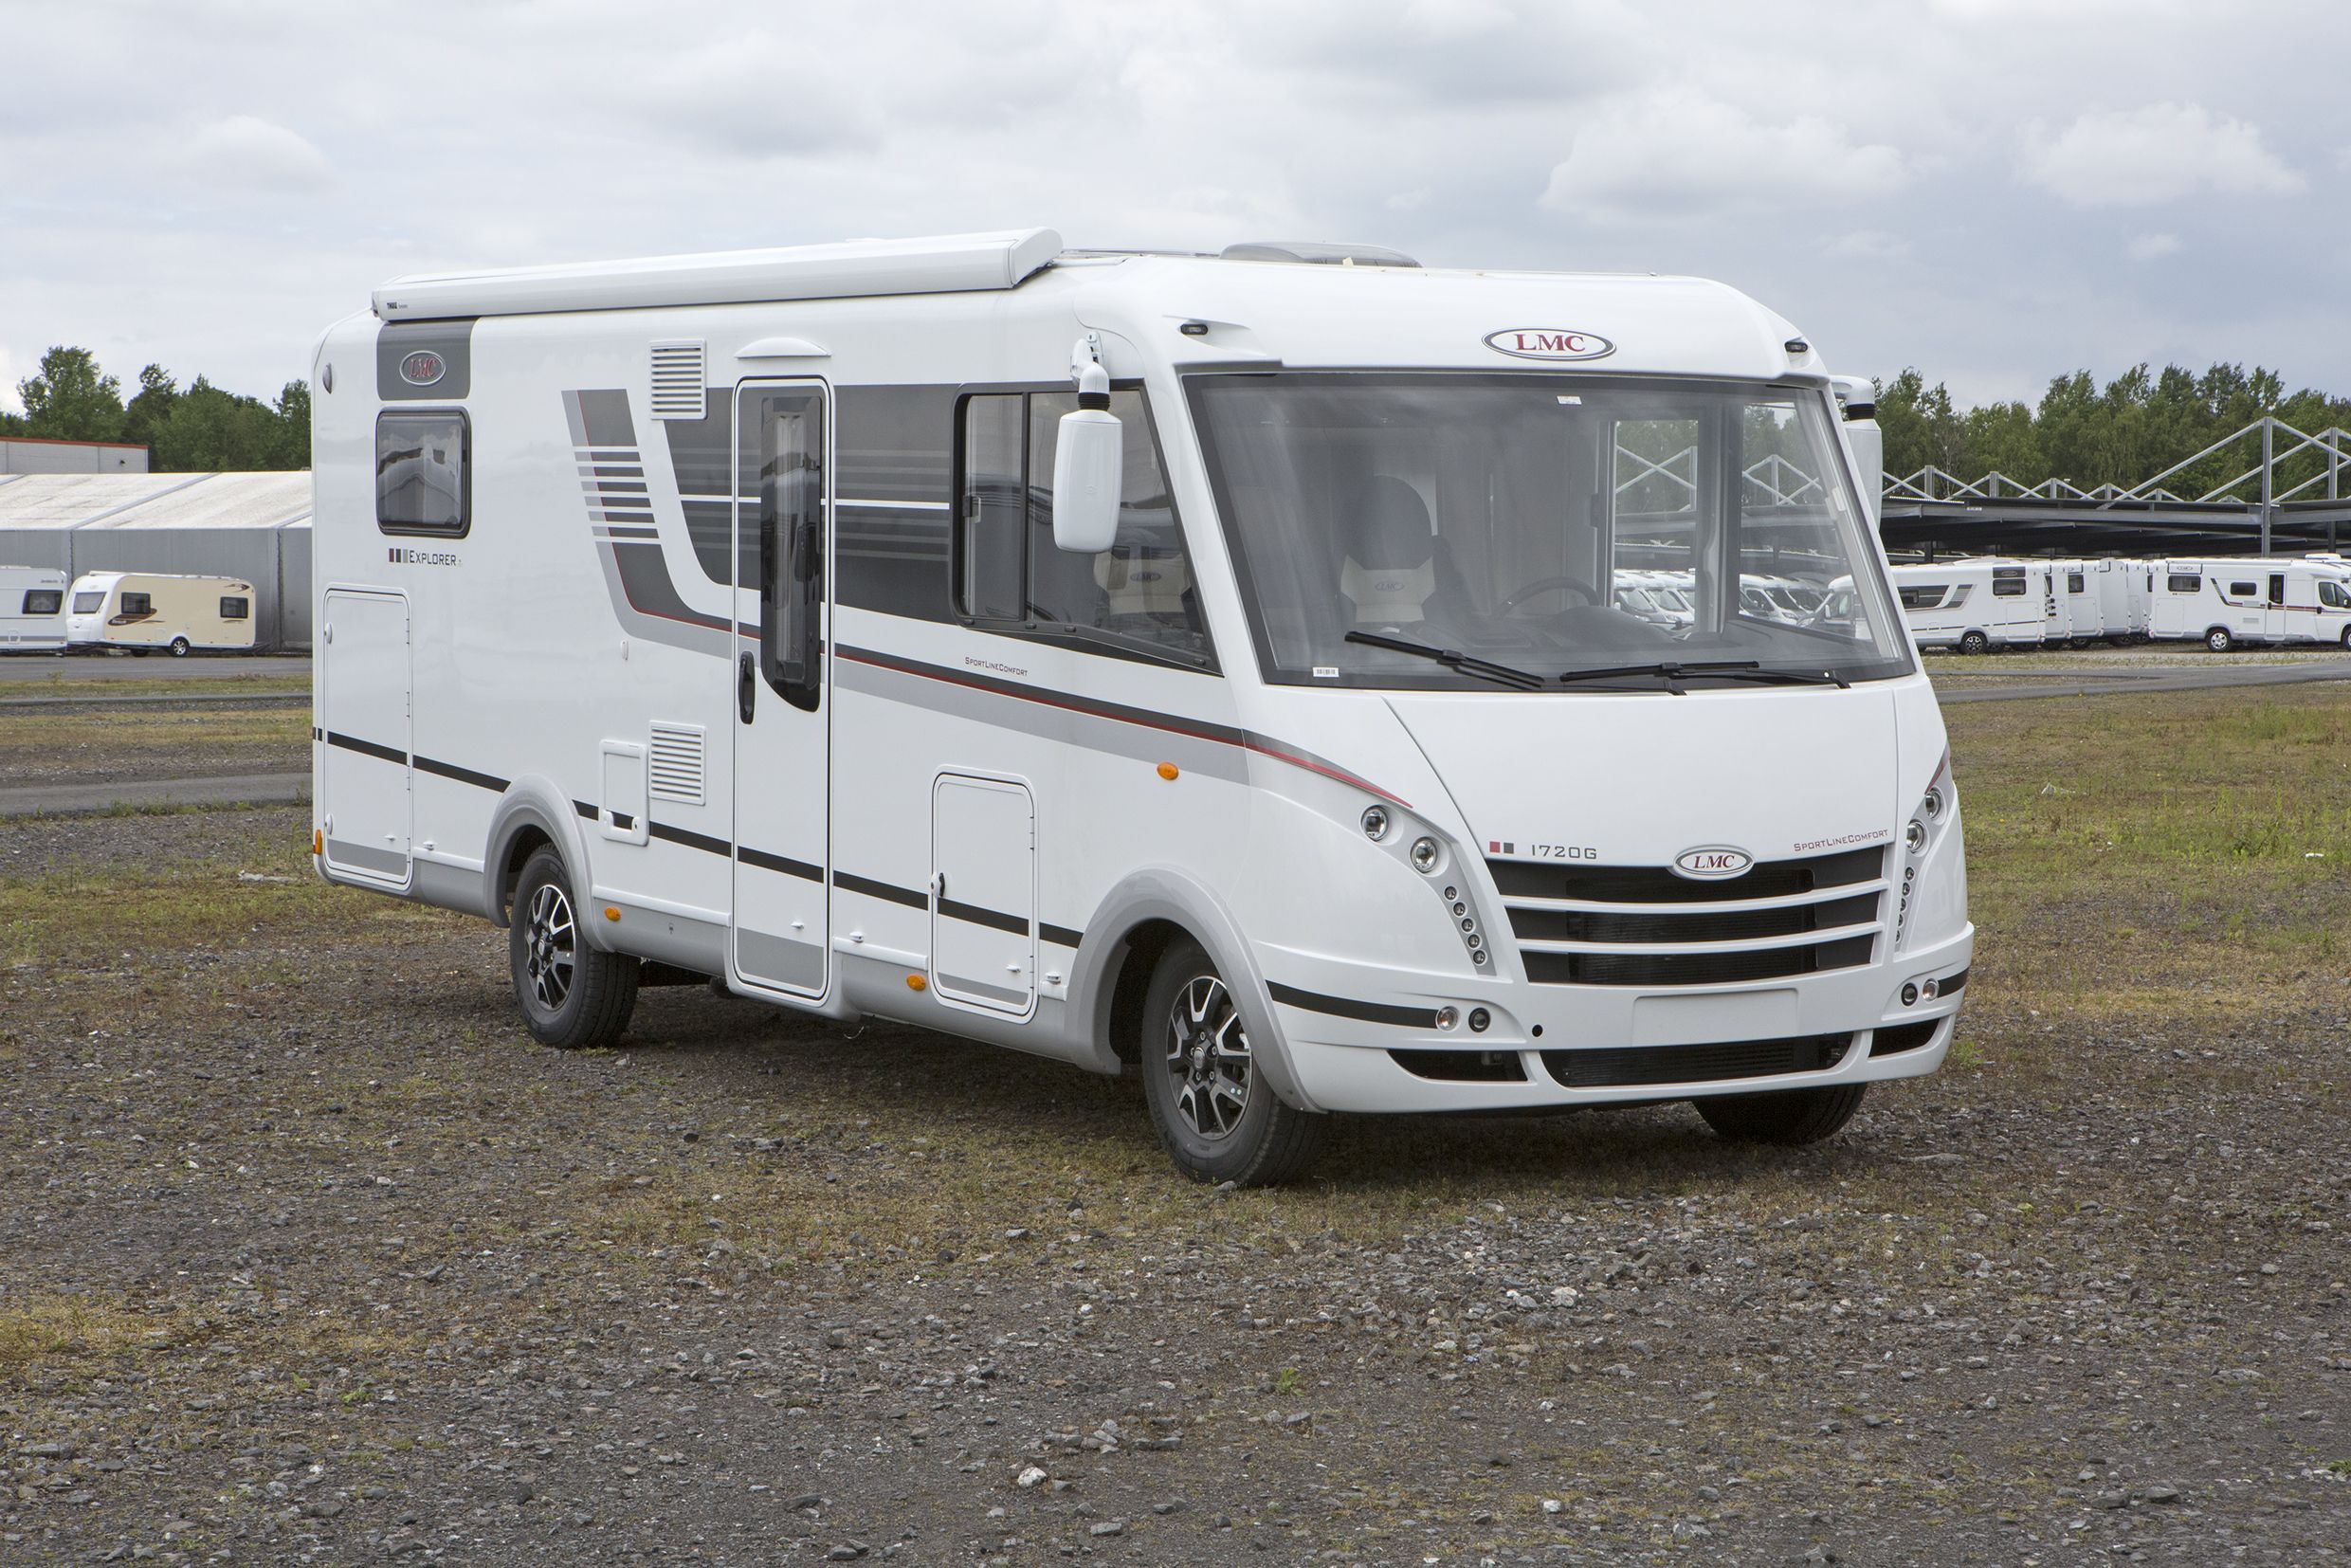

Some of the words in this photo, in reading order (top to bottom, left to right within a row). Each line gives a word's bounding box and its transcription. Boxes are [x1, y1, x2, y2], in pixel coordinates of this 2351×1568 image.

[1515, 334, 1586, 352] LMC
[410, 358, 436, 377] LMC
[1693, 854, 1735, 868] LMC
